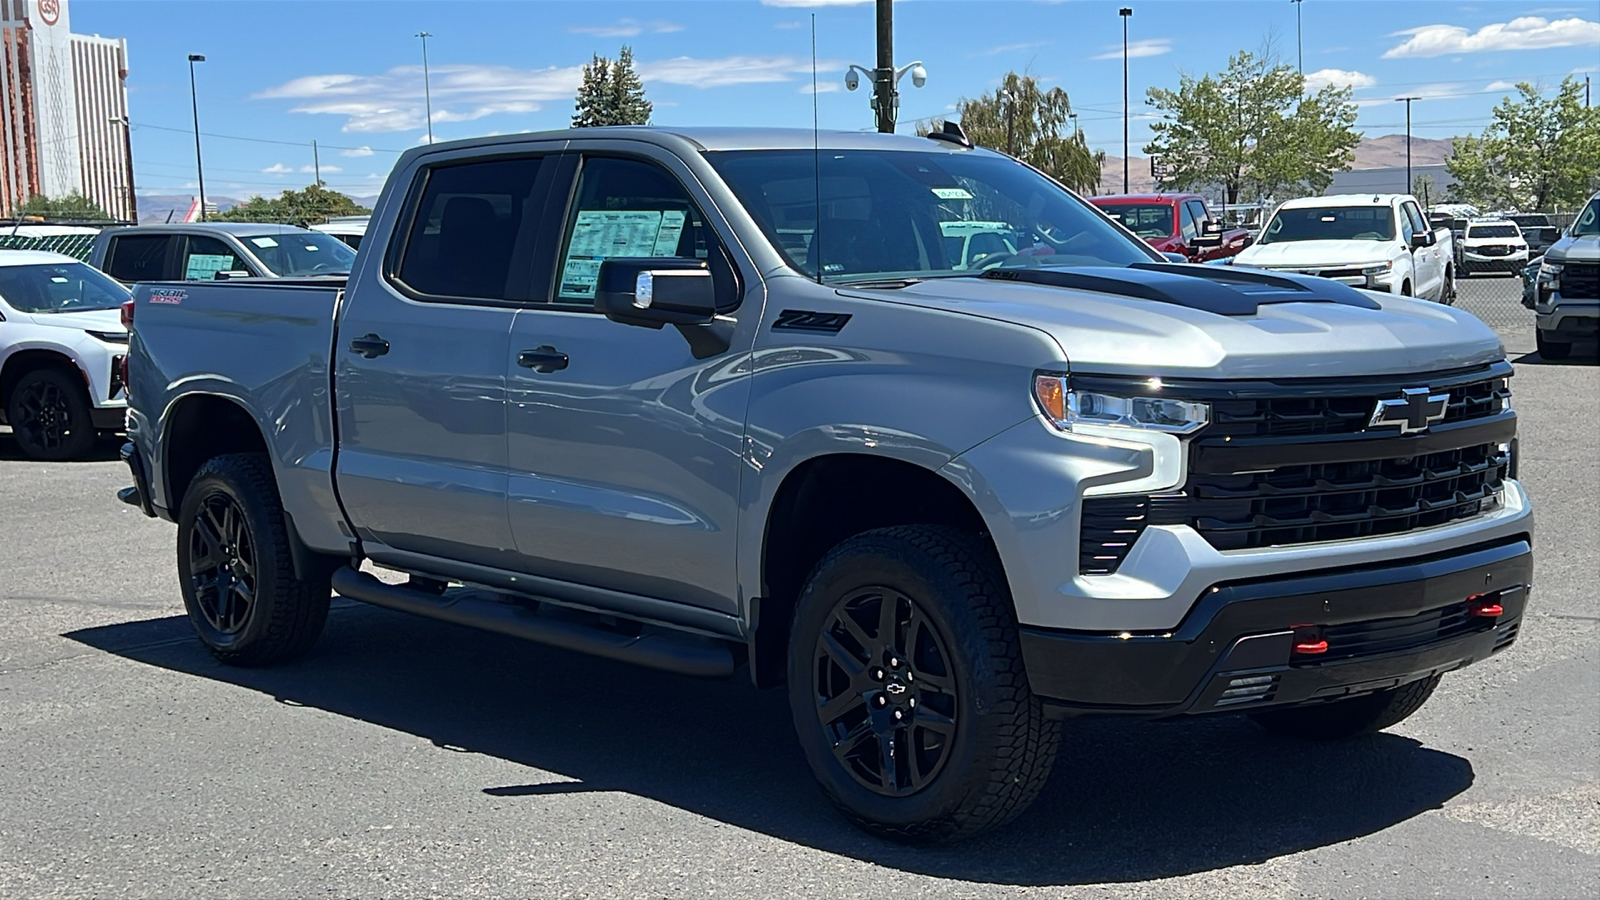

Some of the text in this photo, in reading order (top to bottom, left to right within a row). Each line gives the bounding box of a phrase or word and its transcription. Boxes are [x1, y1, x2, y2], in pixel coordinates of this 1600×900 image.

[150, 288, 189, 299] TRAIL
[149, 295, 182, 304] BOSS
[771, 309, 853, 333] Z71
